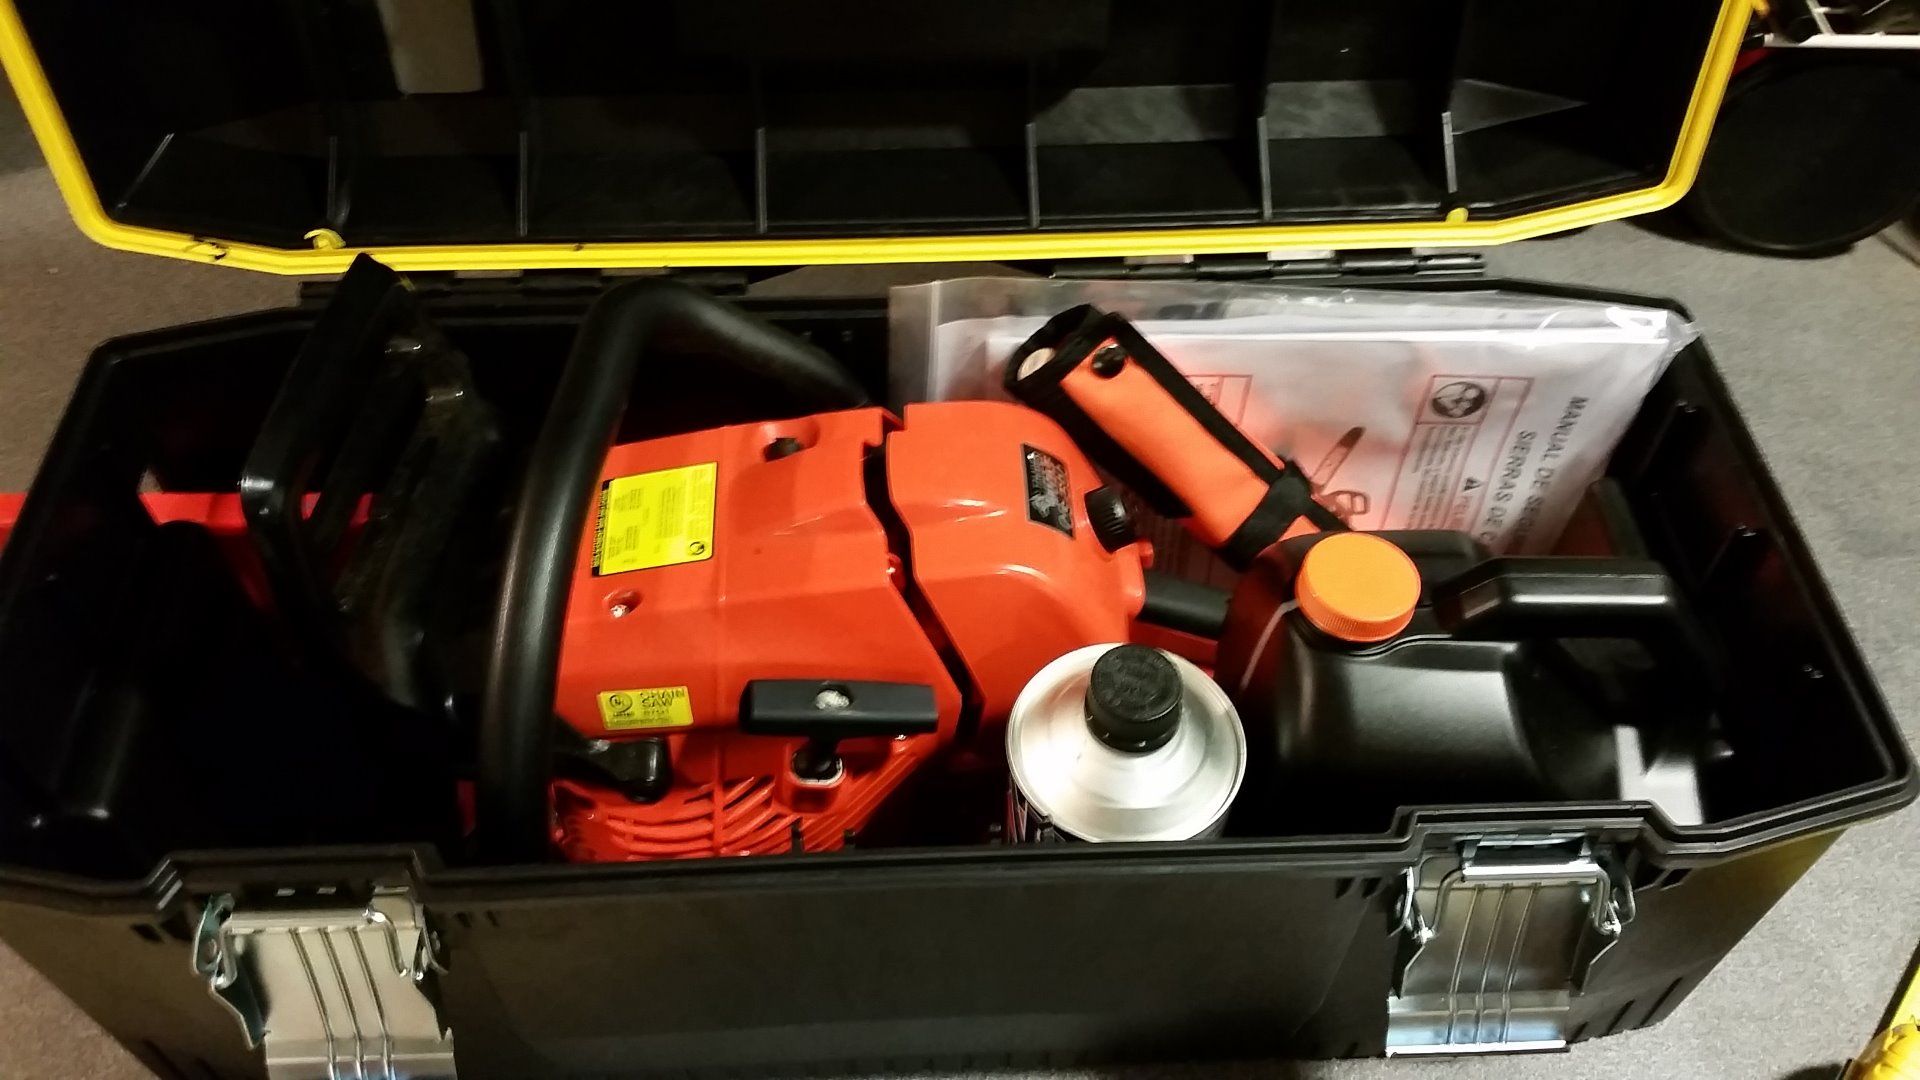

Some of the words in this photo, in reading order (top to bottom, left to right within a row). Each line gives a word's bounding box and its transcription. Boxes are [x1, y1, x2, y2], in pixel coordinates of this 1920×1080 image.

[1542, 396, 1589, 461] MANUAL
[1495, 430, 1537, 502] SIERRAS
[1533, 467, 1555, 488] DE
[1484, 506, 1506, 528] DE
[642, 697, 673, 707] SAW
